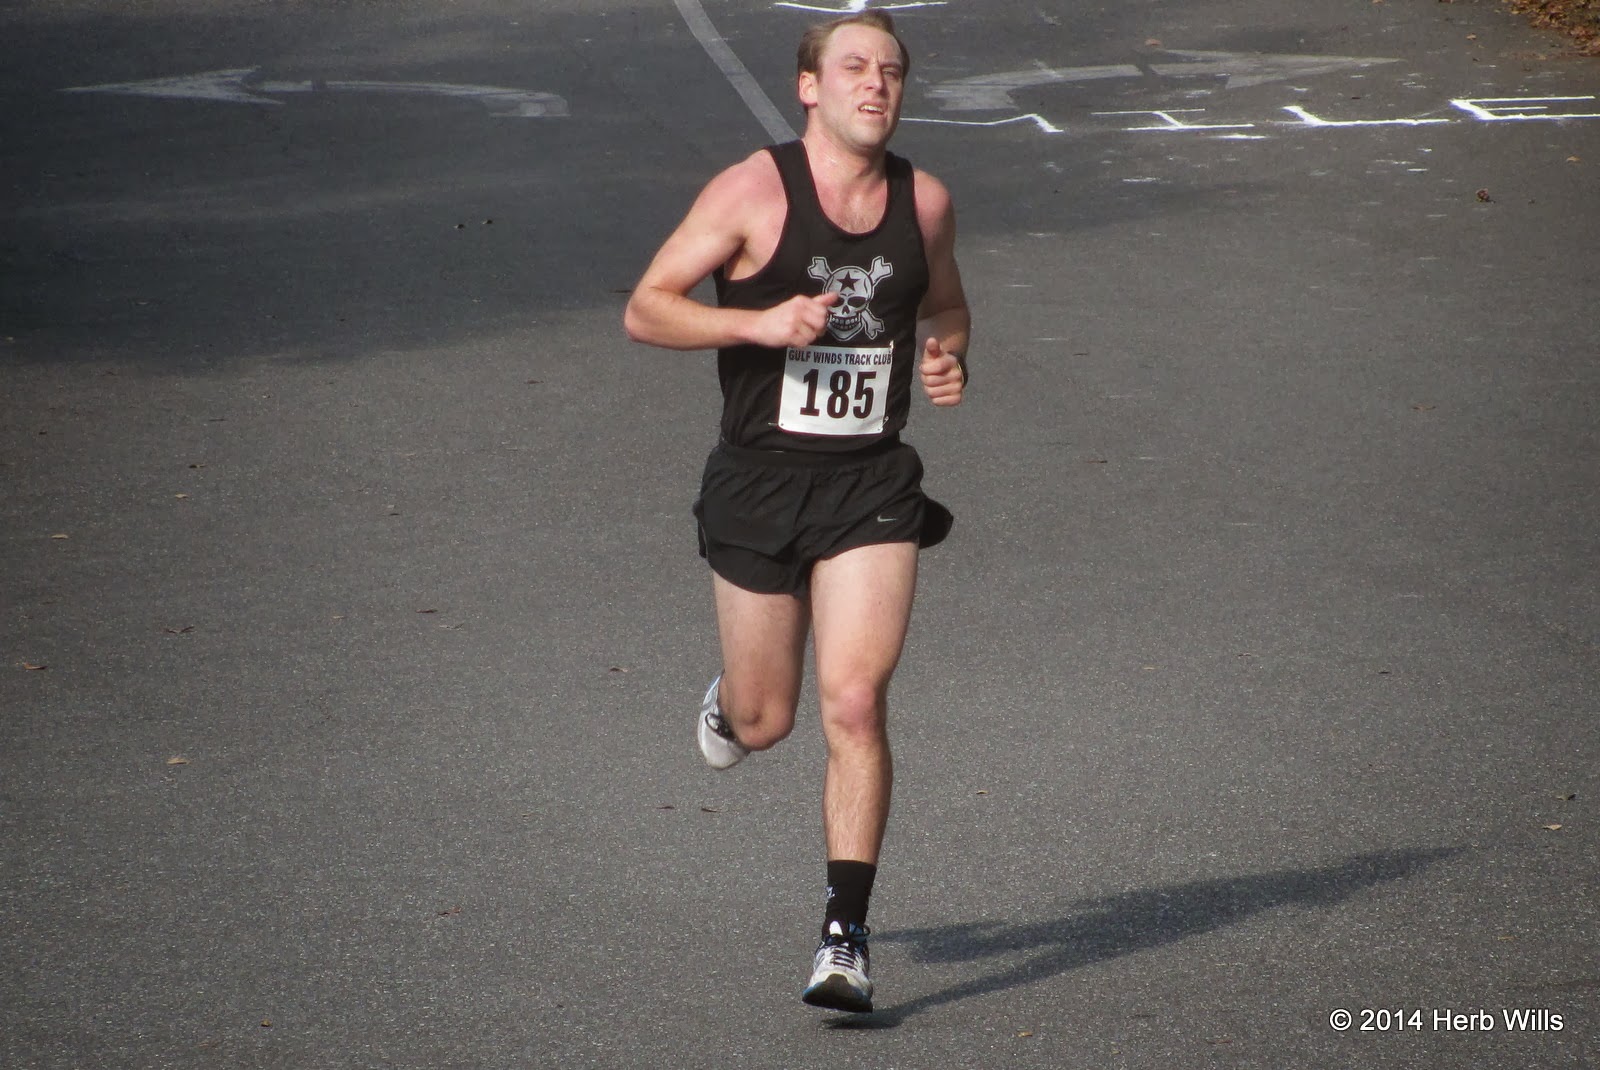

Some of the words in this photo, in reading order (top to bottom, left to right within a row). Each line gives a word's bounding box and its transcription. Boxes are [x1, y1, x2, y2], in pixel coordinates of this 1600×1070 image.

[788, 349, 811, 362] GULF
[813, 351, 842, 364] WINDS
[845, 353, 872, 365] TRACK
[873, 353, 892, 365] CLUB
[800, 368, 877, 419] 185
